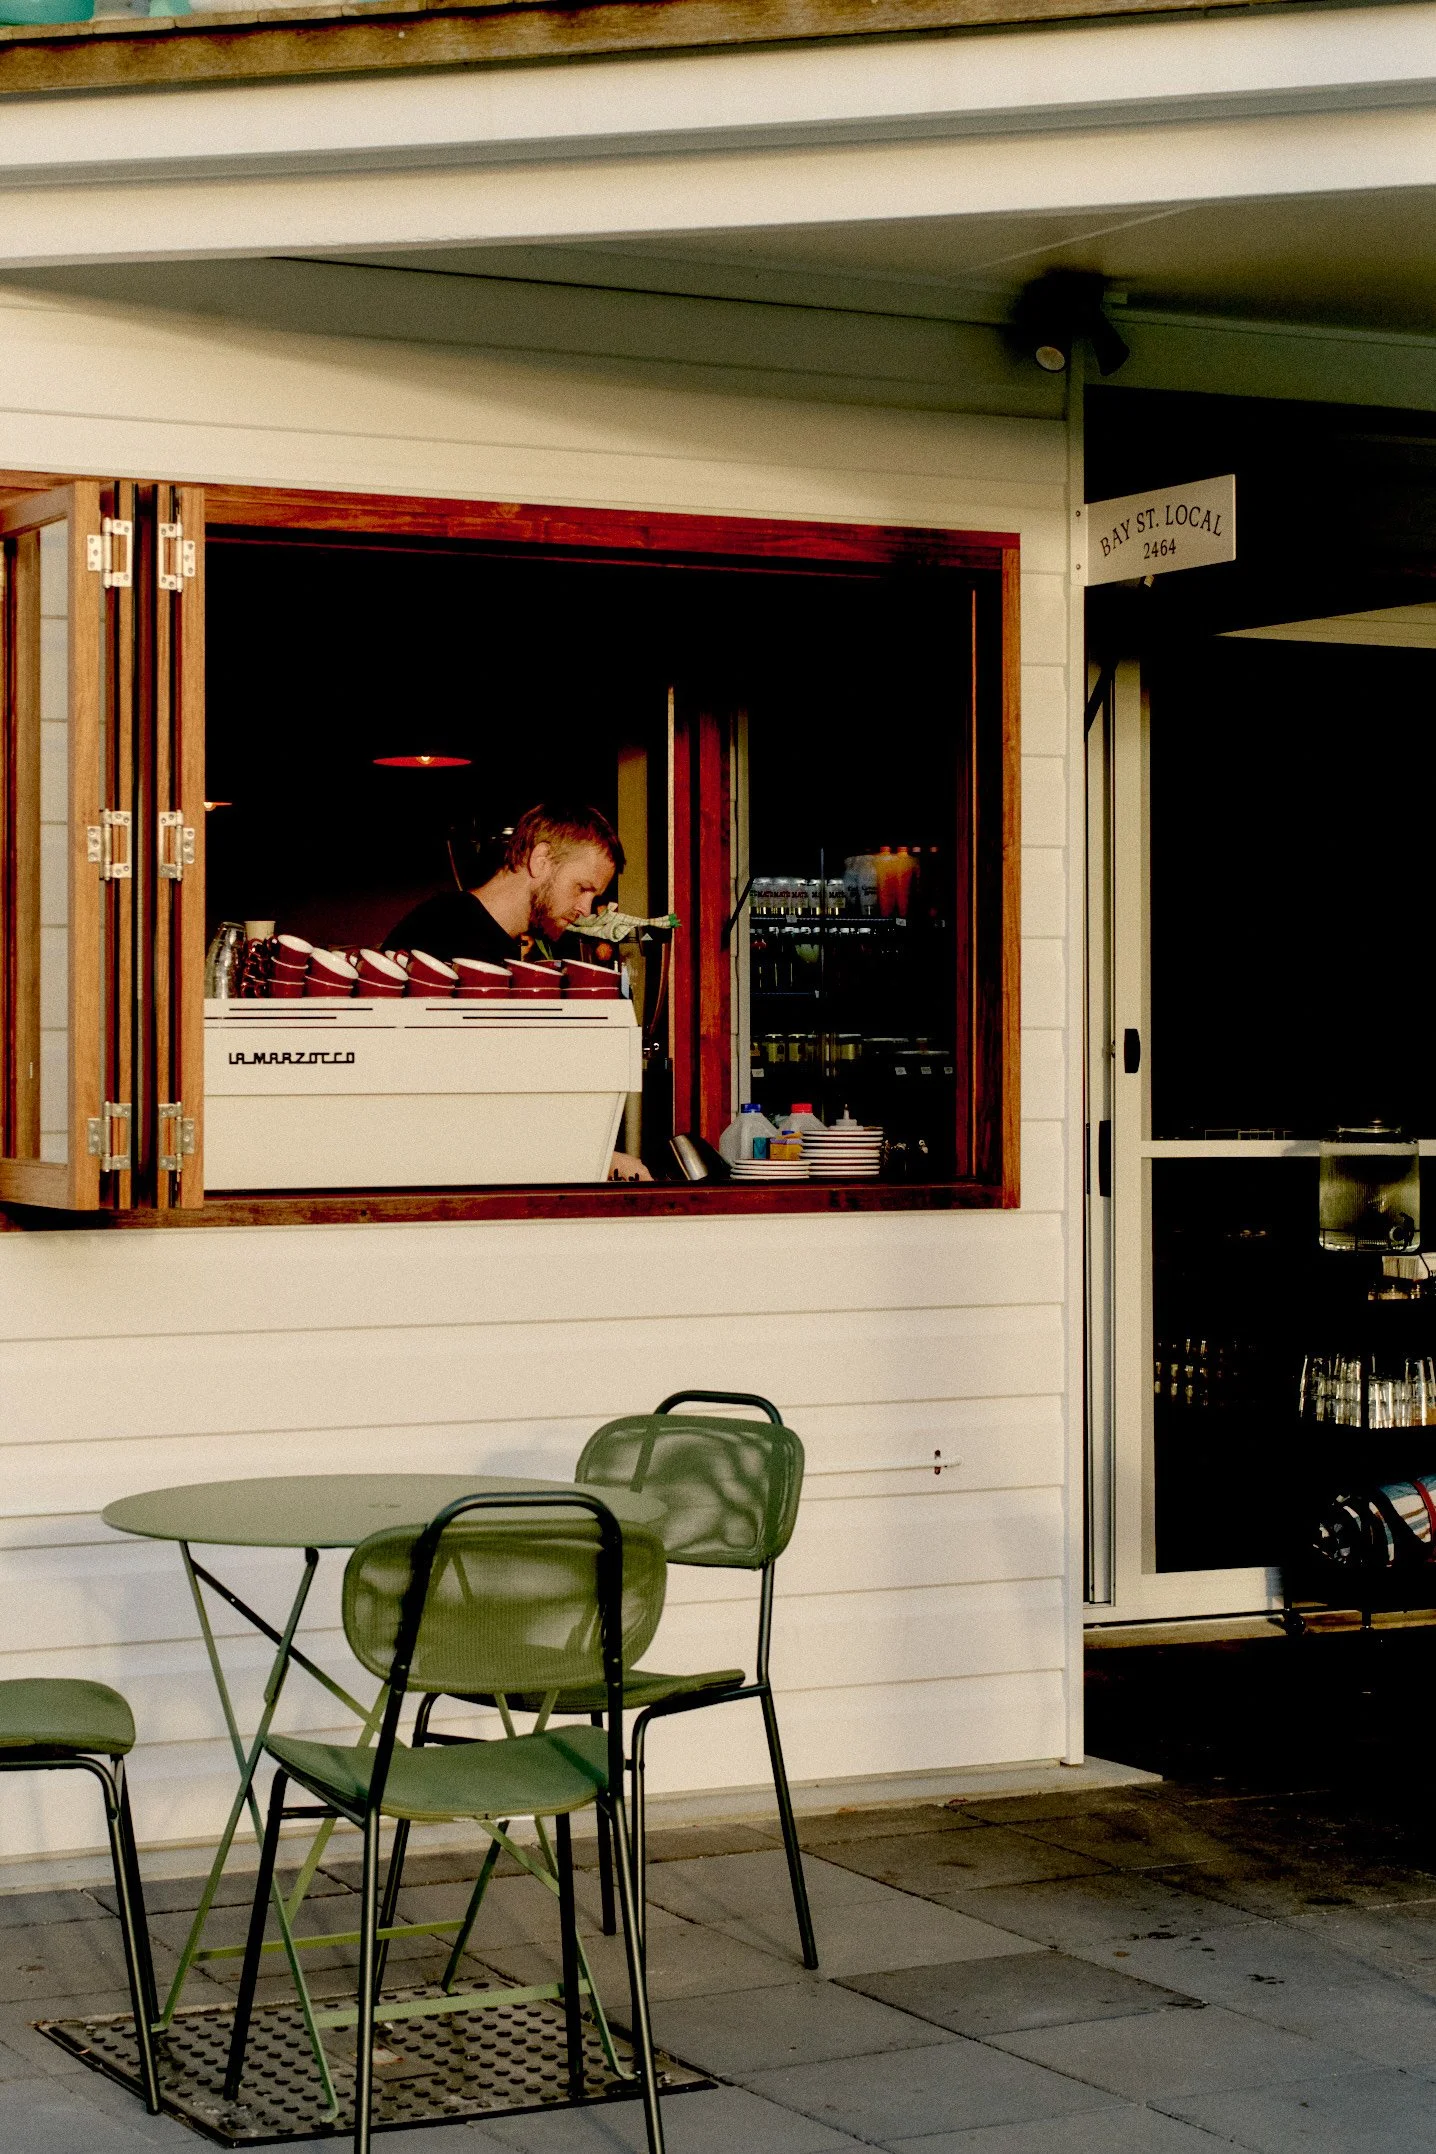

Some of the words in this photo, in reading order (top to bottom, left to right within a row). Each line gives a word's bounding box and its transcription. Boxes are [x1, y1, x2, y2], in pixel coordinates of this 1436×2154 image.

[1100, 519, 1130, 556] BAY
[1136, 508, 1159, 533] ST.
[1165, 504, 1222, 537] LOCAL
[1143, 538, 1177, 560] 2464
[253, 1052, 355, 1064] MARZOCCO
